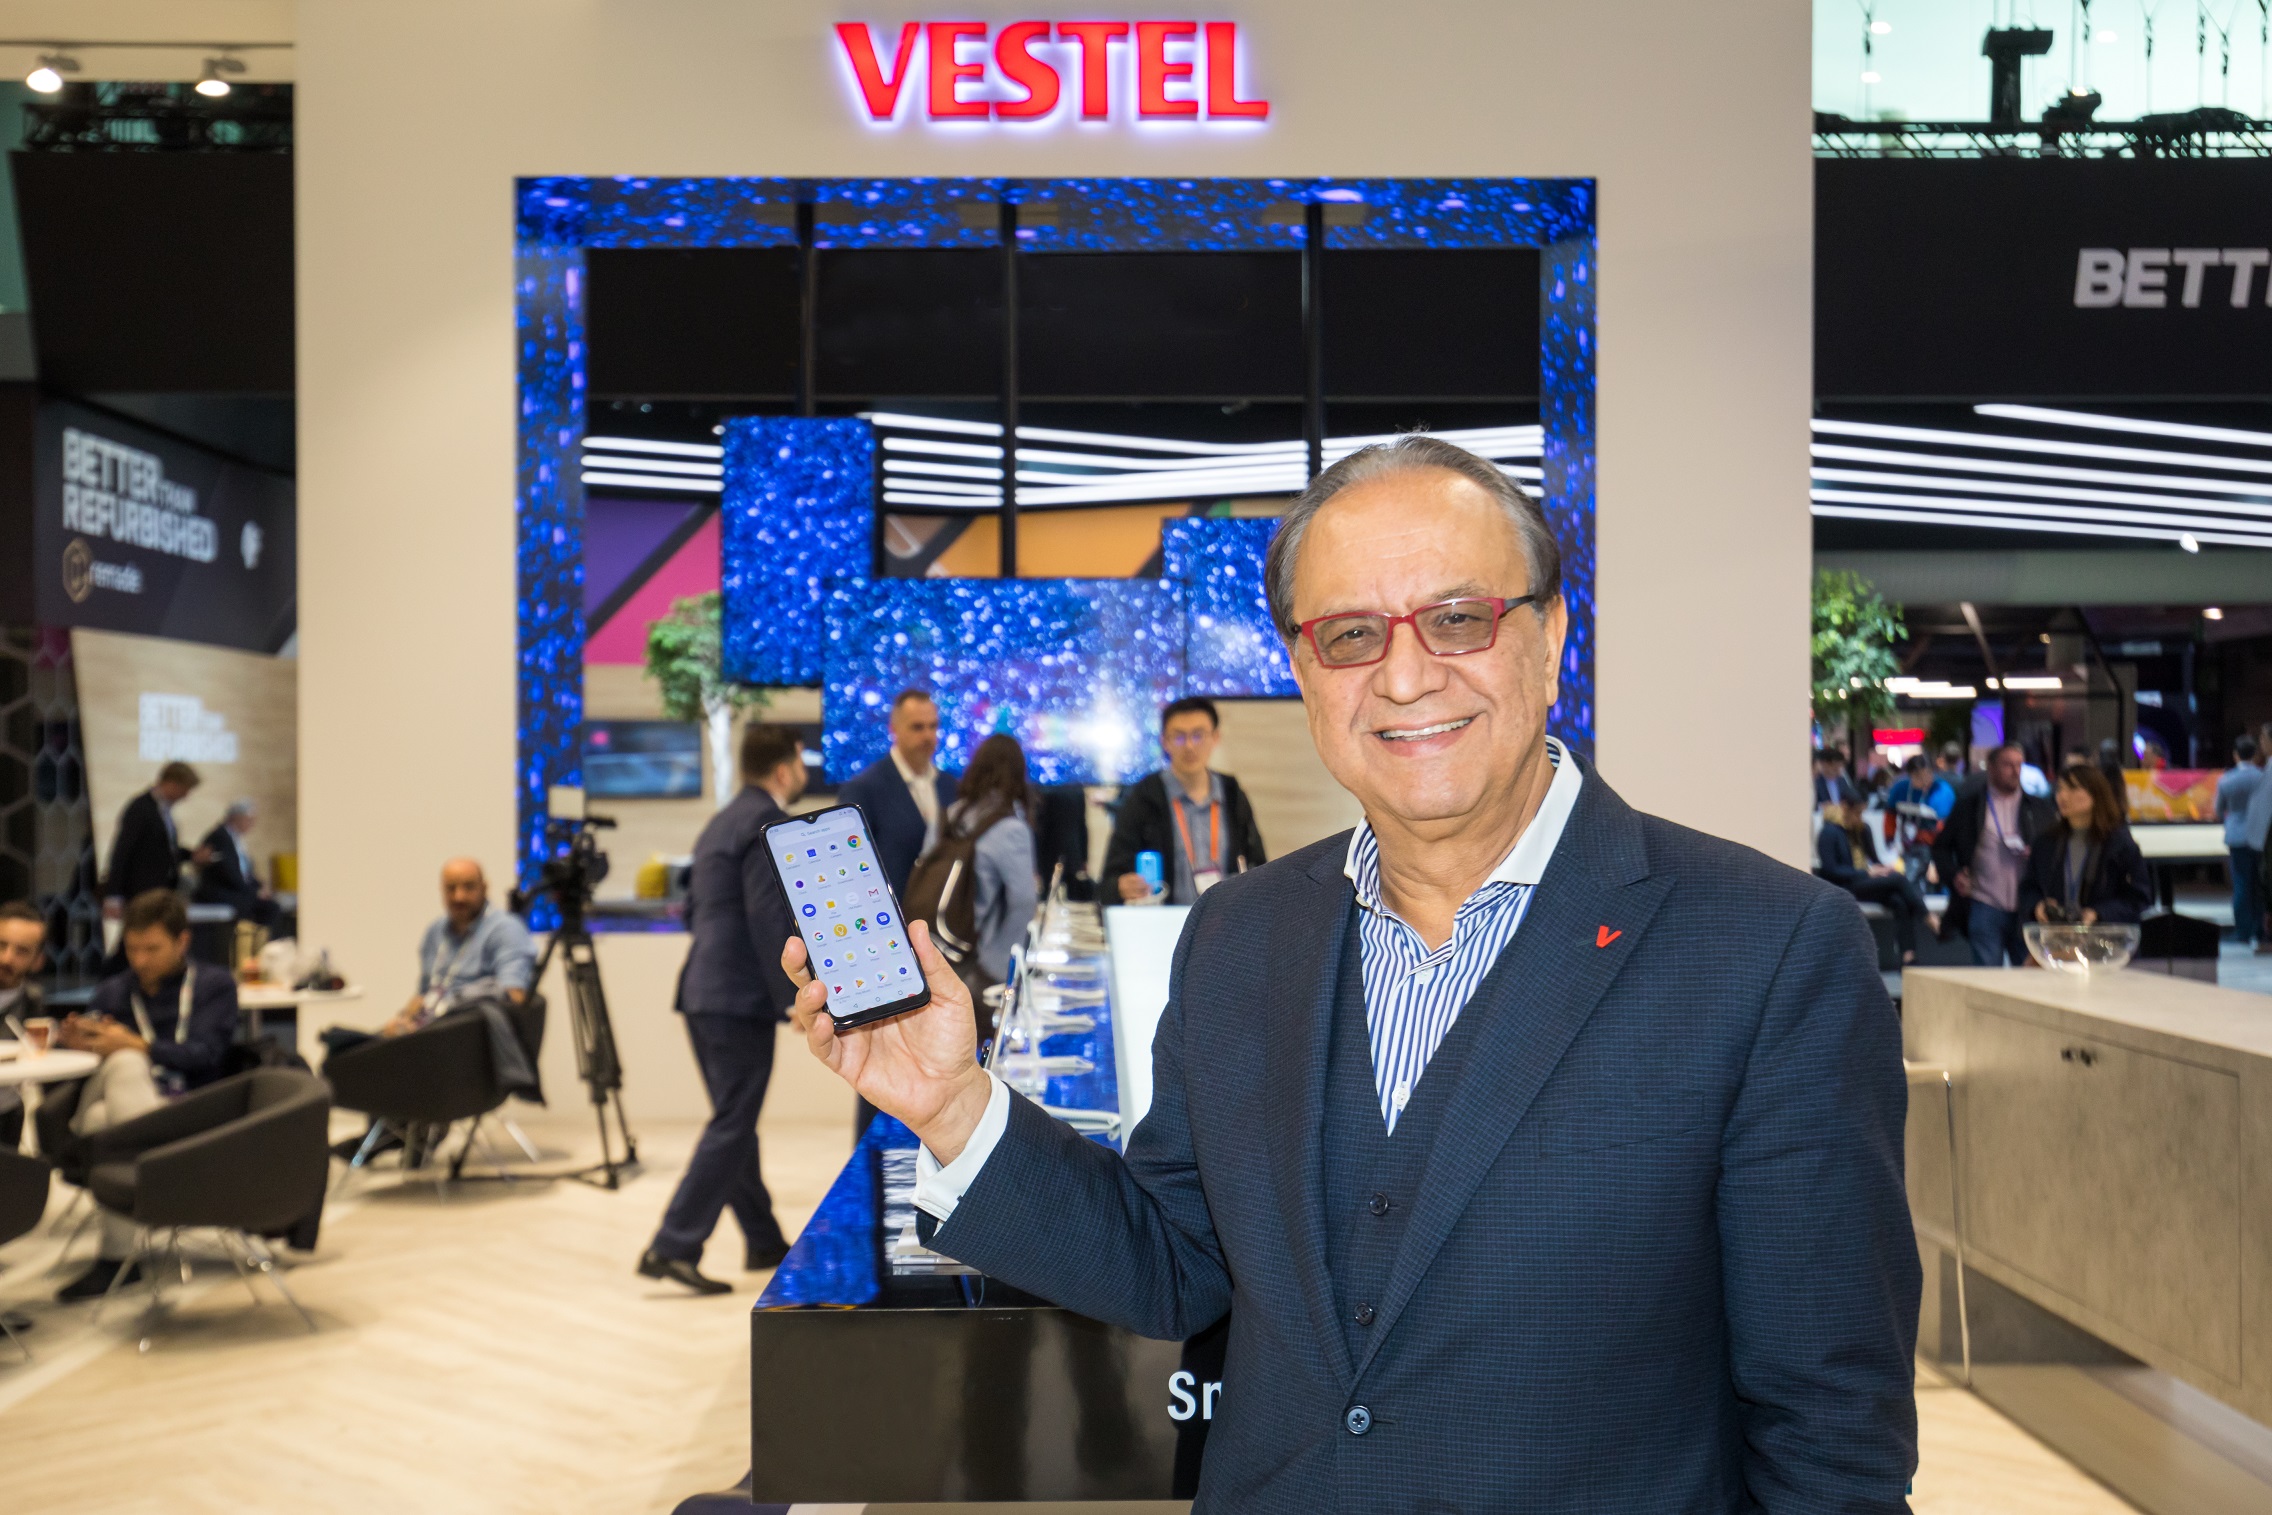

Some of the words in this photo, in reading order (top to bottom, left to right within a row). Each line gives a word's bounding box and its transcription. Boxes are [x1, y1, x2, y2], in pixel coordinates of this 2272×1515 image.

[835, 21, 1270, 117] VESTEL
[2073, 247, 2272, 308] BETT
[62, 427, 163, 501] BETTER
[62, 484, 219, 563] REFURBISHED
